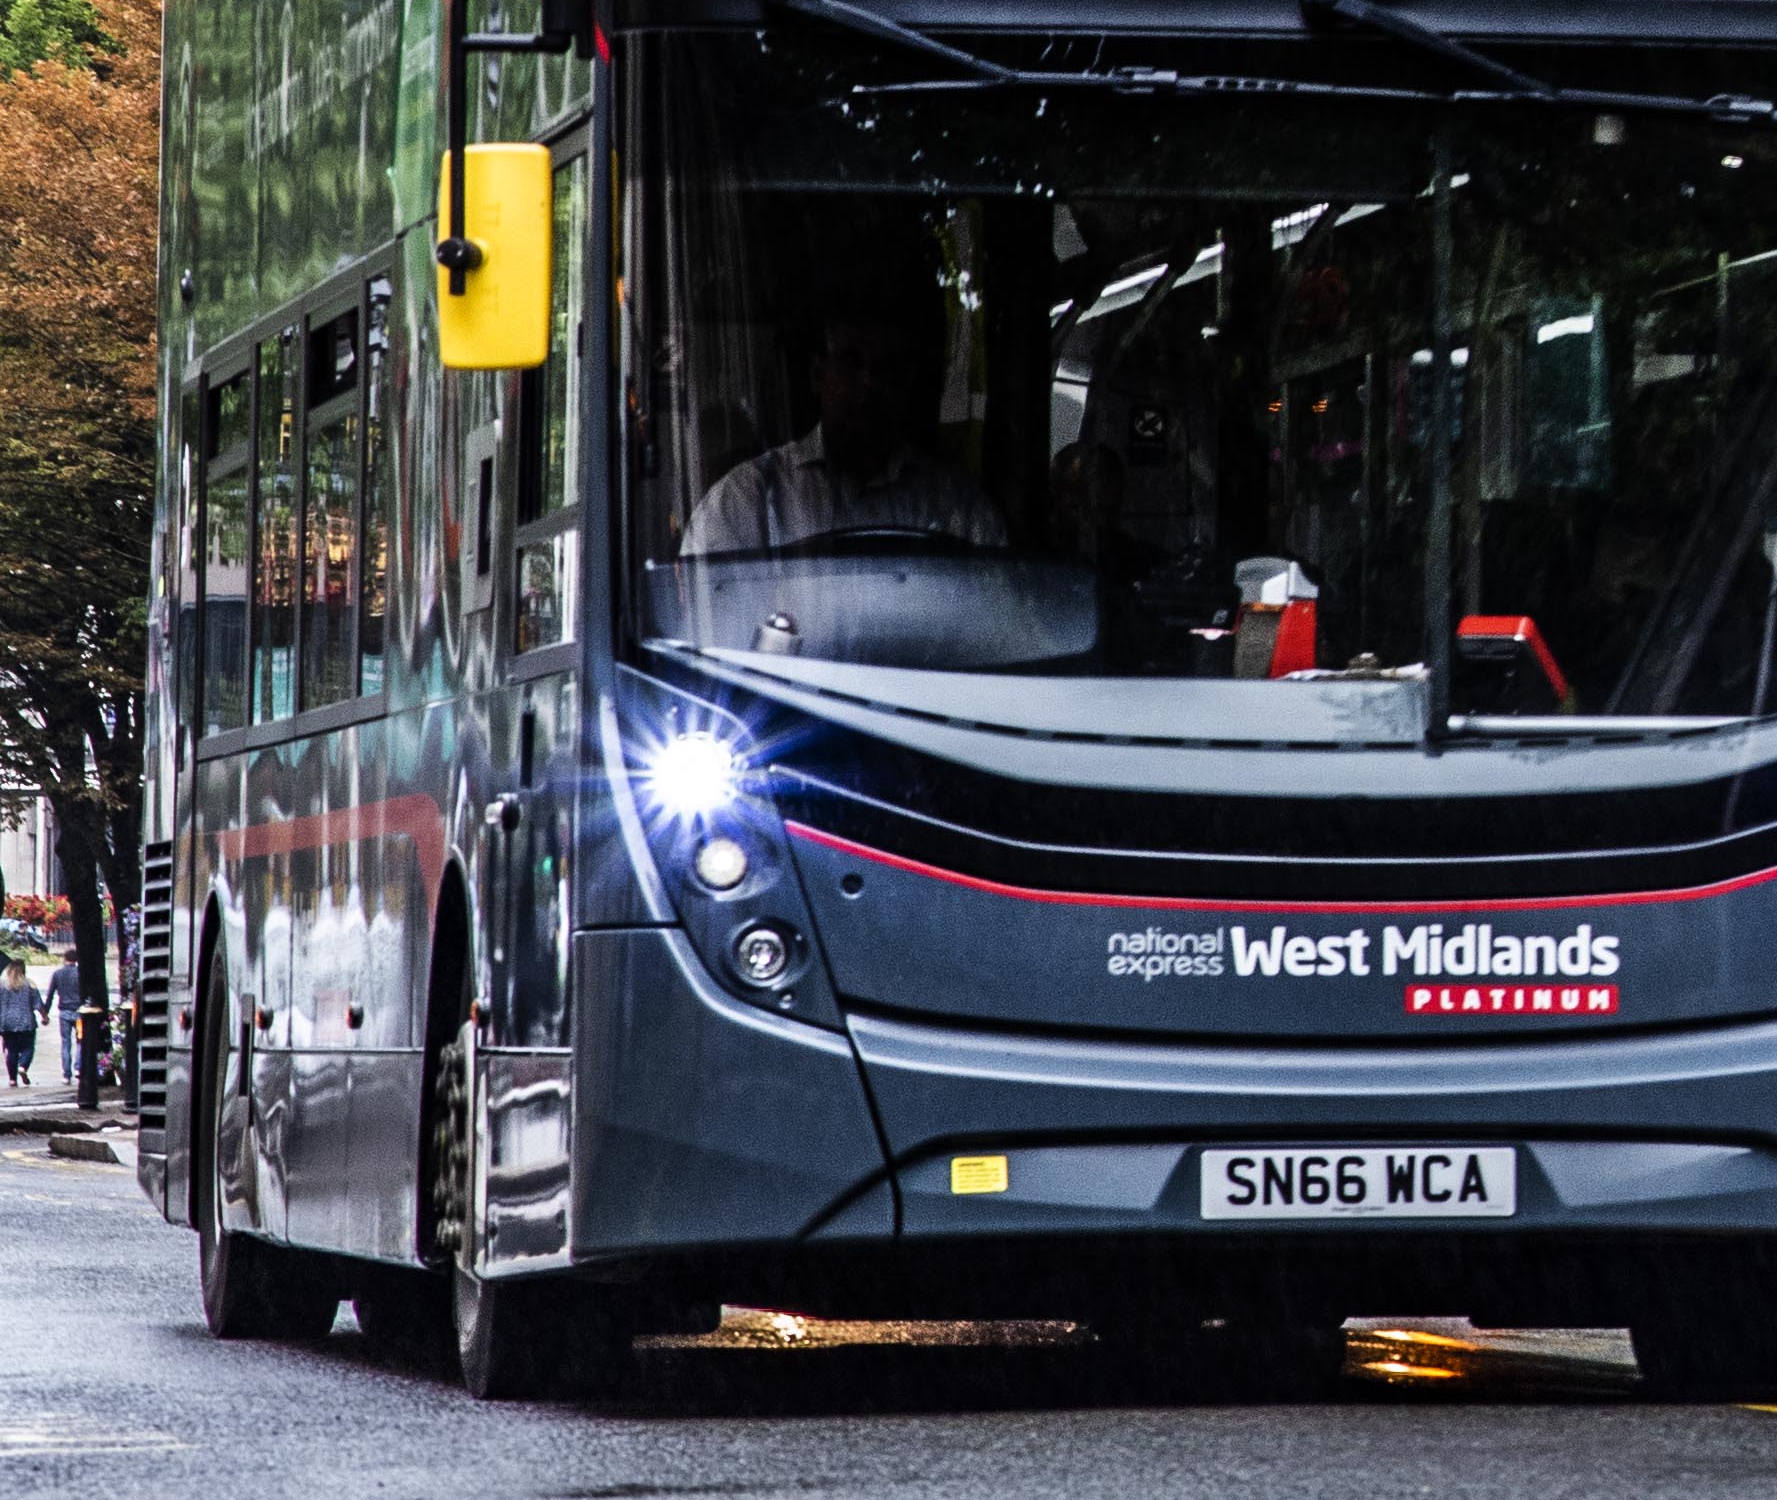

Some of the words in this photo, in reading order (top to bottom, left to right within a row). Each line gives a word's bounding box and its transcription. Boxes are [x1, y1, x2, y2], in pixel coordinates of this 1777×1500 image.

[1108, 927, 1224, 954] national
[1231, 926, 1369, 977] West
[1383, 924, 1619, 977] Midlands
[1108, 954, 1224, 982] express
[1412, 988, 1611, 1010] PLATINUM
[1226, 1156, 1367, 1205] SN66
[1386, 1154, 1488, 1203] WCA
